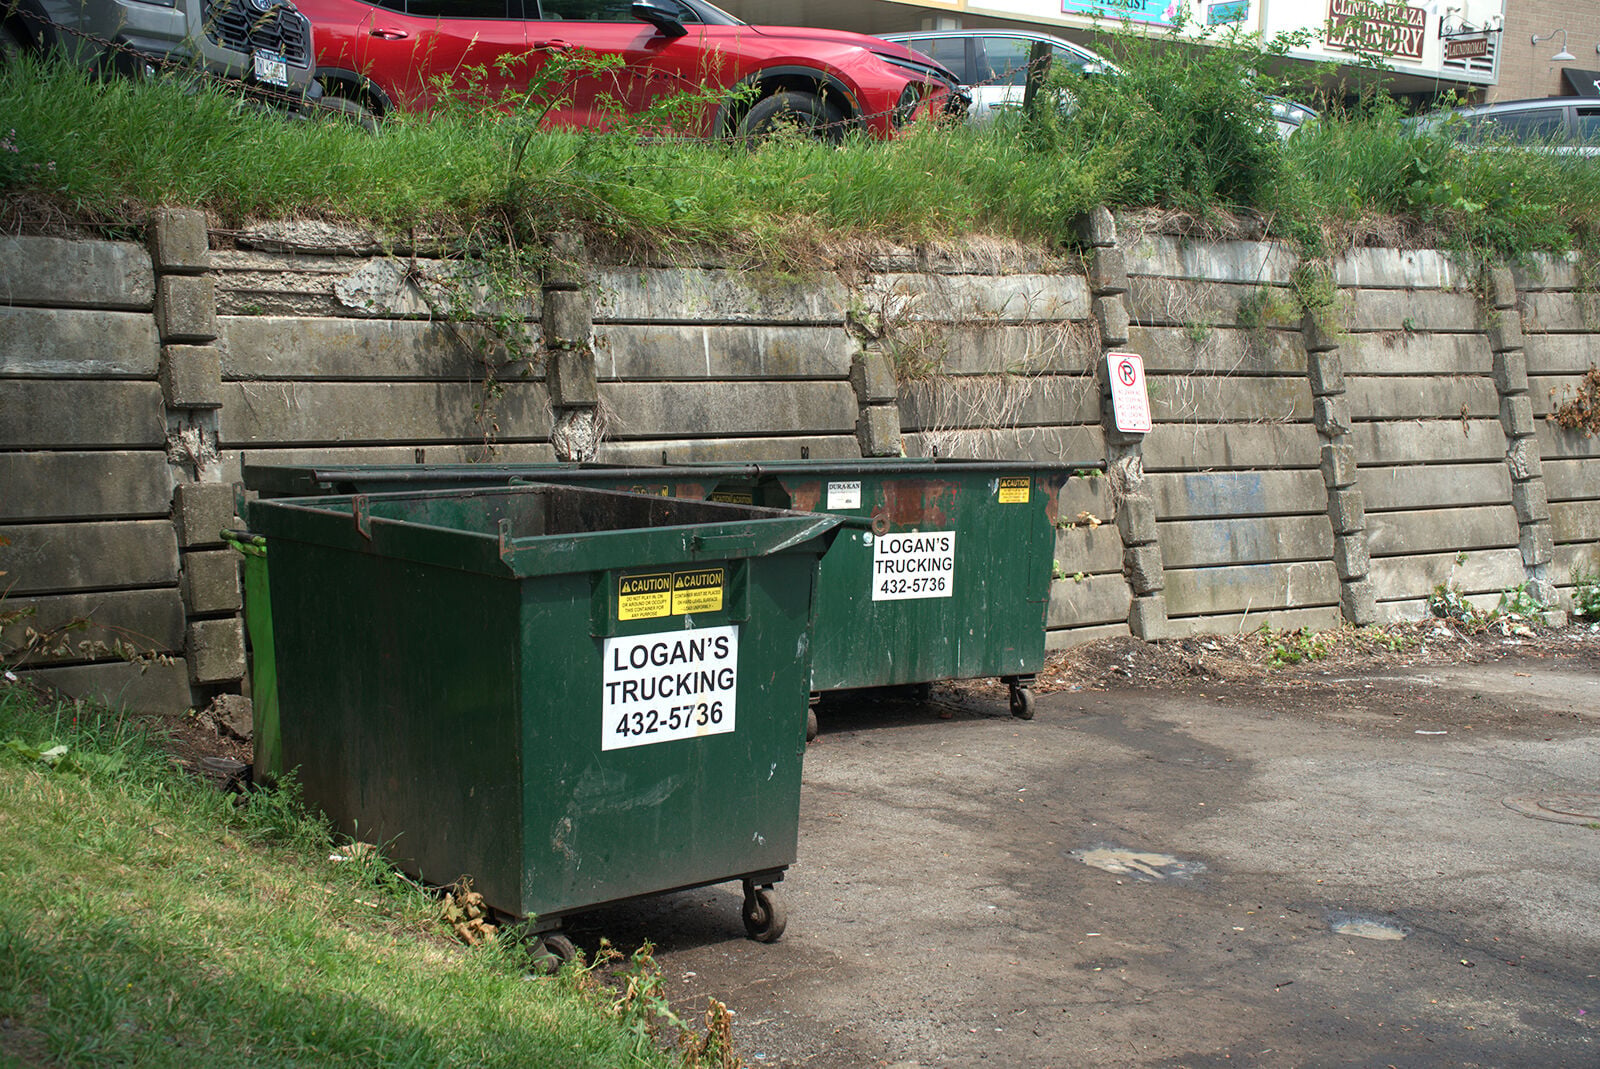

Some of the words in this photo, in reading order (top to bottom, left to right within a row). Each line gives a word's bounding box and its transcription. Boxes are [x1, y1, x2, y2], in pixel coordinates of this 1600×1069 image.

[1329, 16, 1424, 56] LAUNDRY
[1449, 41, 1486, 56] LAUNDROMAT
[1007, 479, 1029, 487] CAUTION
[880, 537, 949, 554] LOGAN'S
[875, 557, 952, 574] TRUCKING
[631, 578, 669, 592] CAUTION
[684, 573, 721, 587] CAUTION
[880, 576, 945, 594] 432-5736
[614, 636, 729, 671] LOGAN'S
[606, 668, 734, 705] TRUCKING
[616, 701, 723, 737] 432-5736
